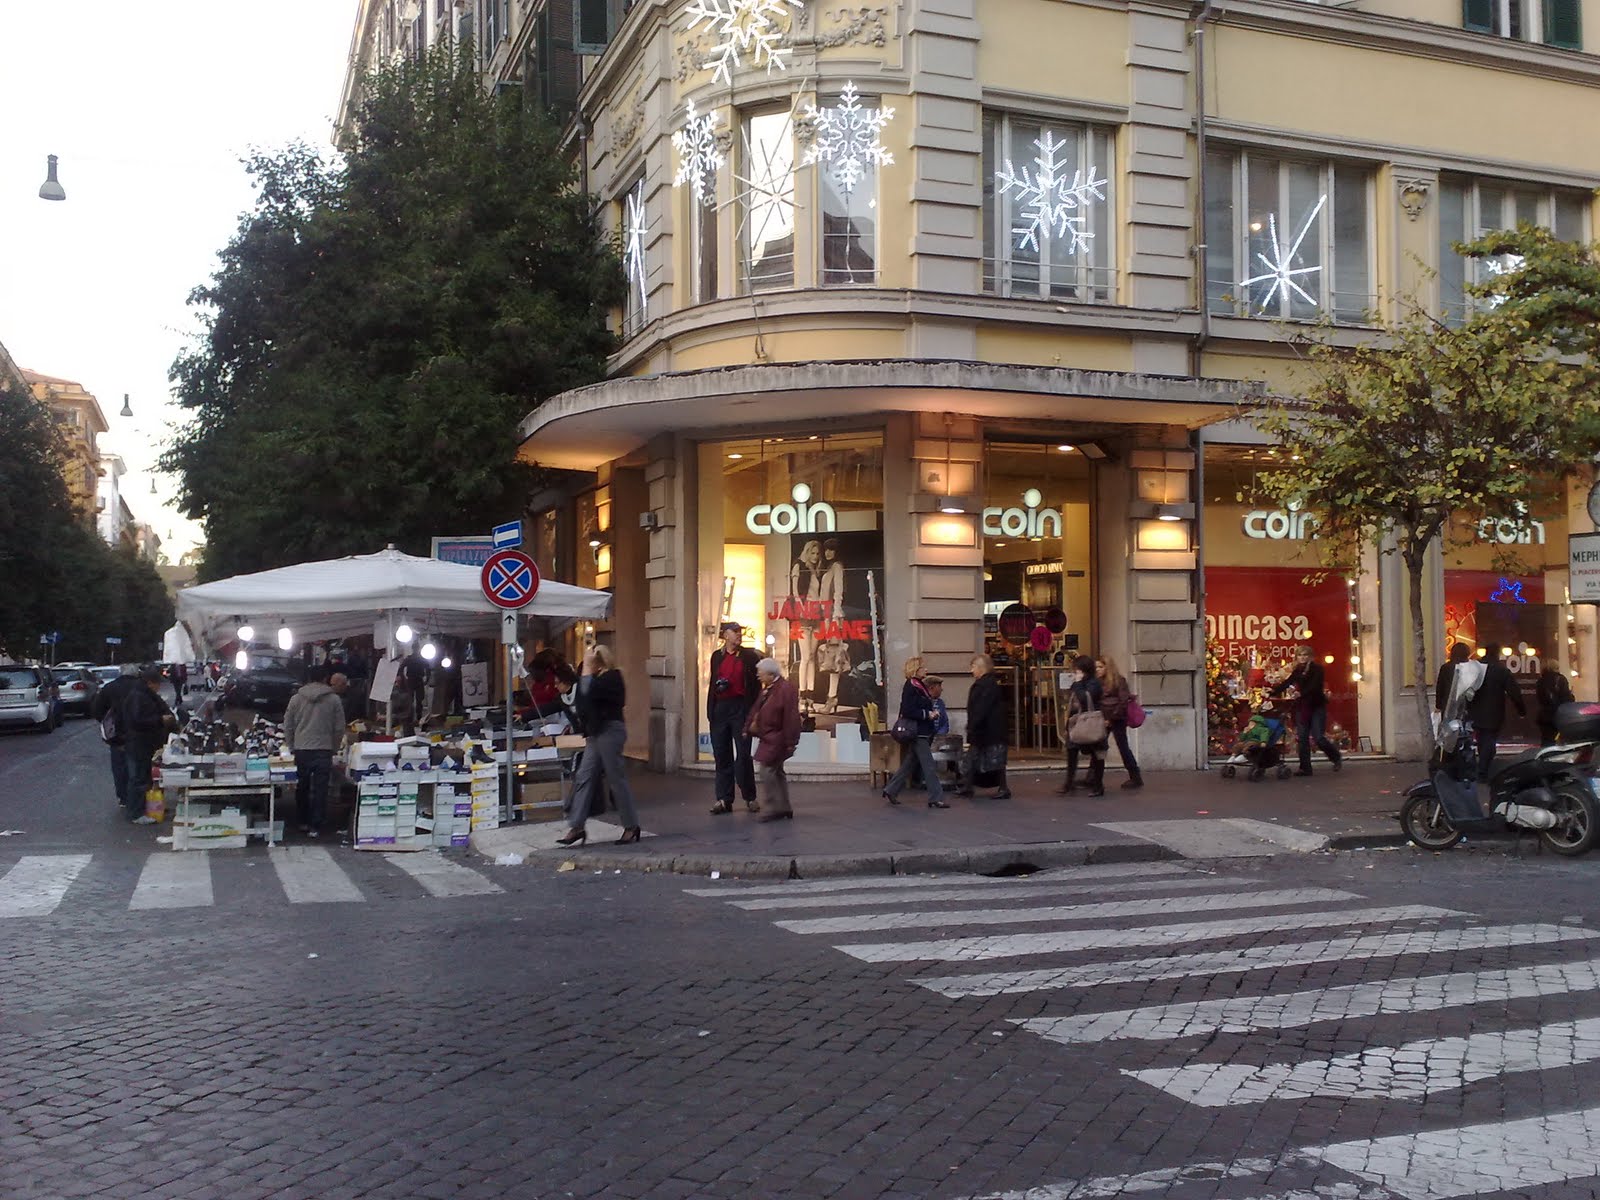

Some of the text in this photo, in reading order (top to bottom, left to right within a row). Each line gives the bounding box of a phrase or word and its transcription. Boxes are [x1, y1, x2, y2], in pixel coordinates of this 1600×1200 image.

[746, 483, 836, 535] coin
[983, 488, 1062, 537] coin
[1573, 551, 1600, 562] MEPH
[768, 600, 834, 620] JANET
[790, 620, 804, 641] &
[1204, 613, 1310, 641] oincasa
[1499, 641, 1541, 674] oin
